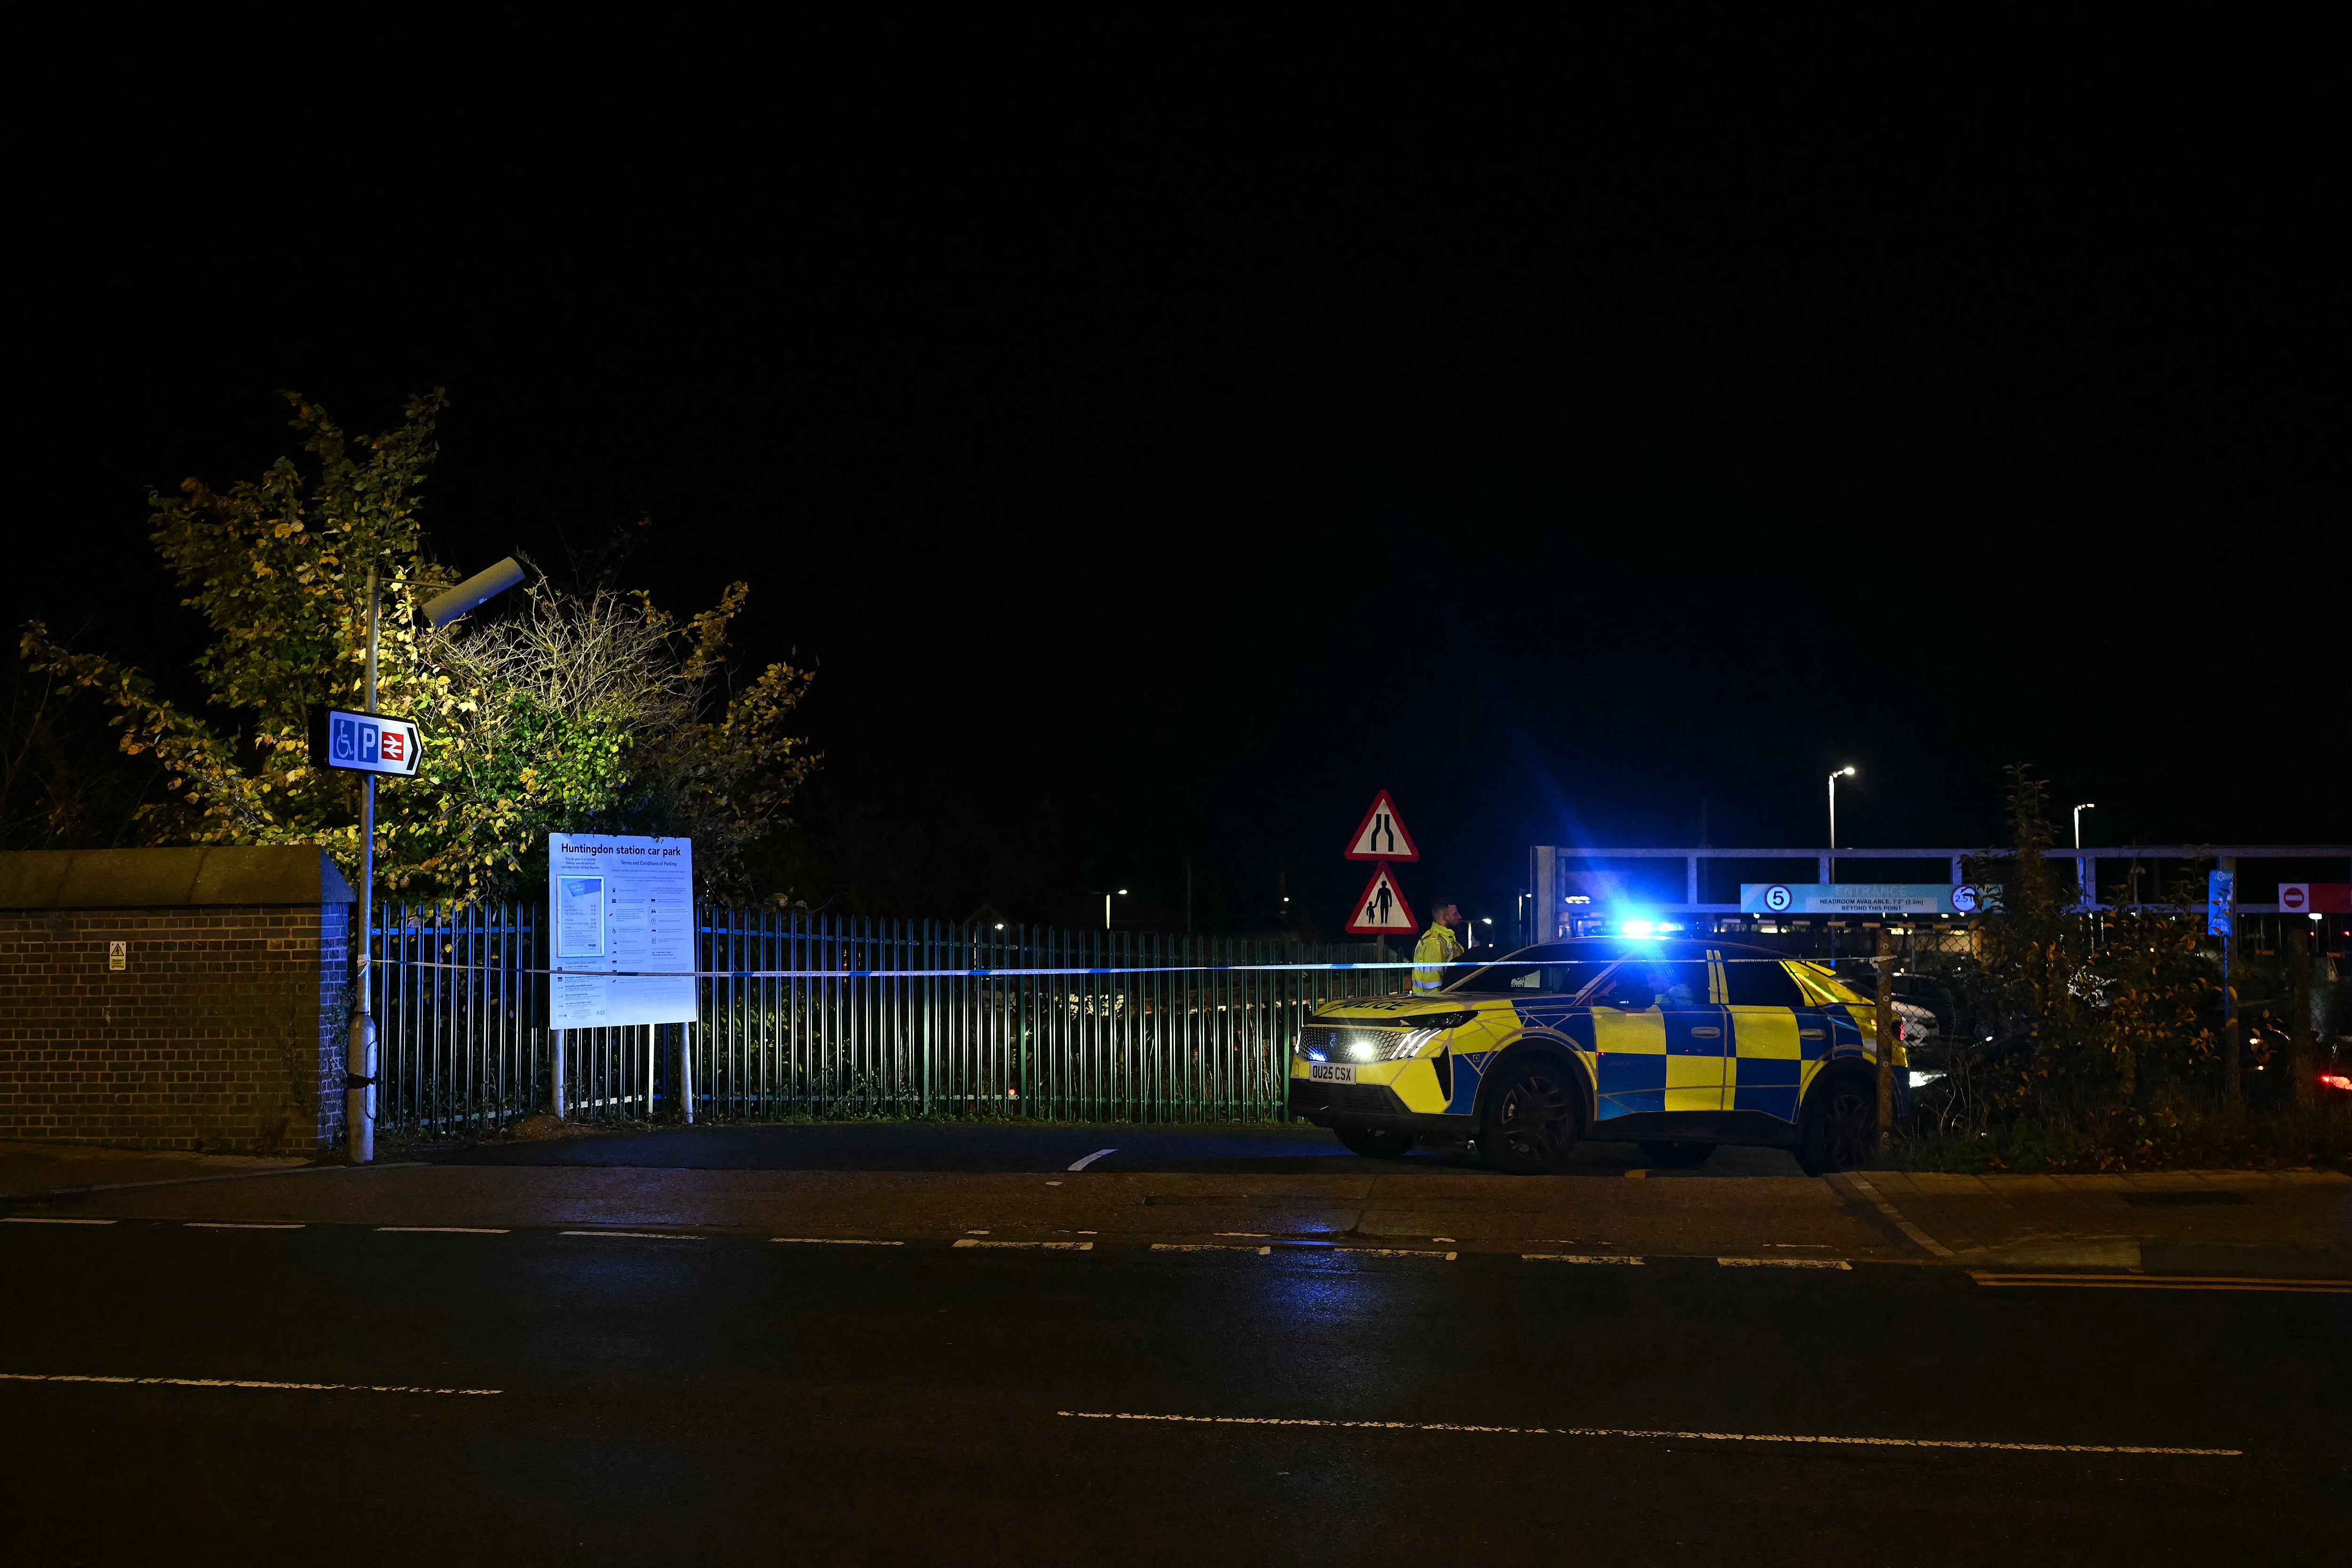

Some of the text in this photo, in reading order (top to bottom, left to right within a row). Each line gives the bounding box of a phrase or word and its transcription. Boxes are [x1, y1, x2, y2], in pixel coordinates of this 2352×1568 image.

[362, 727, 376, 758] P
[561, 843, 613, 856] Huntingdon
[616, 845, 645, 854] station
[663, 846, 681, 858] park
[1772, 891, 1784, 905] 5
[1836, 886, 1907, 896] ENTRANCE
[1312, 1067, 1351, 1081] OU25 CSX
